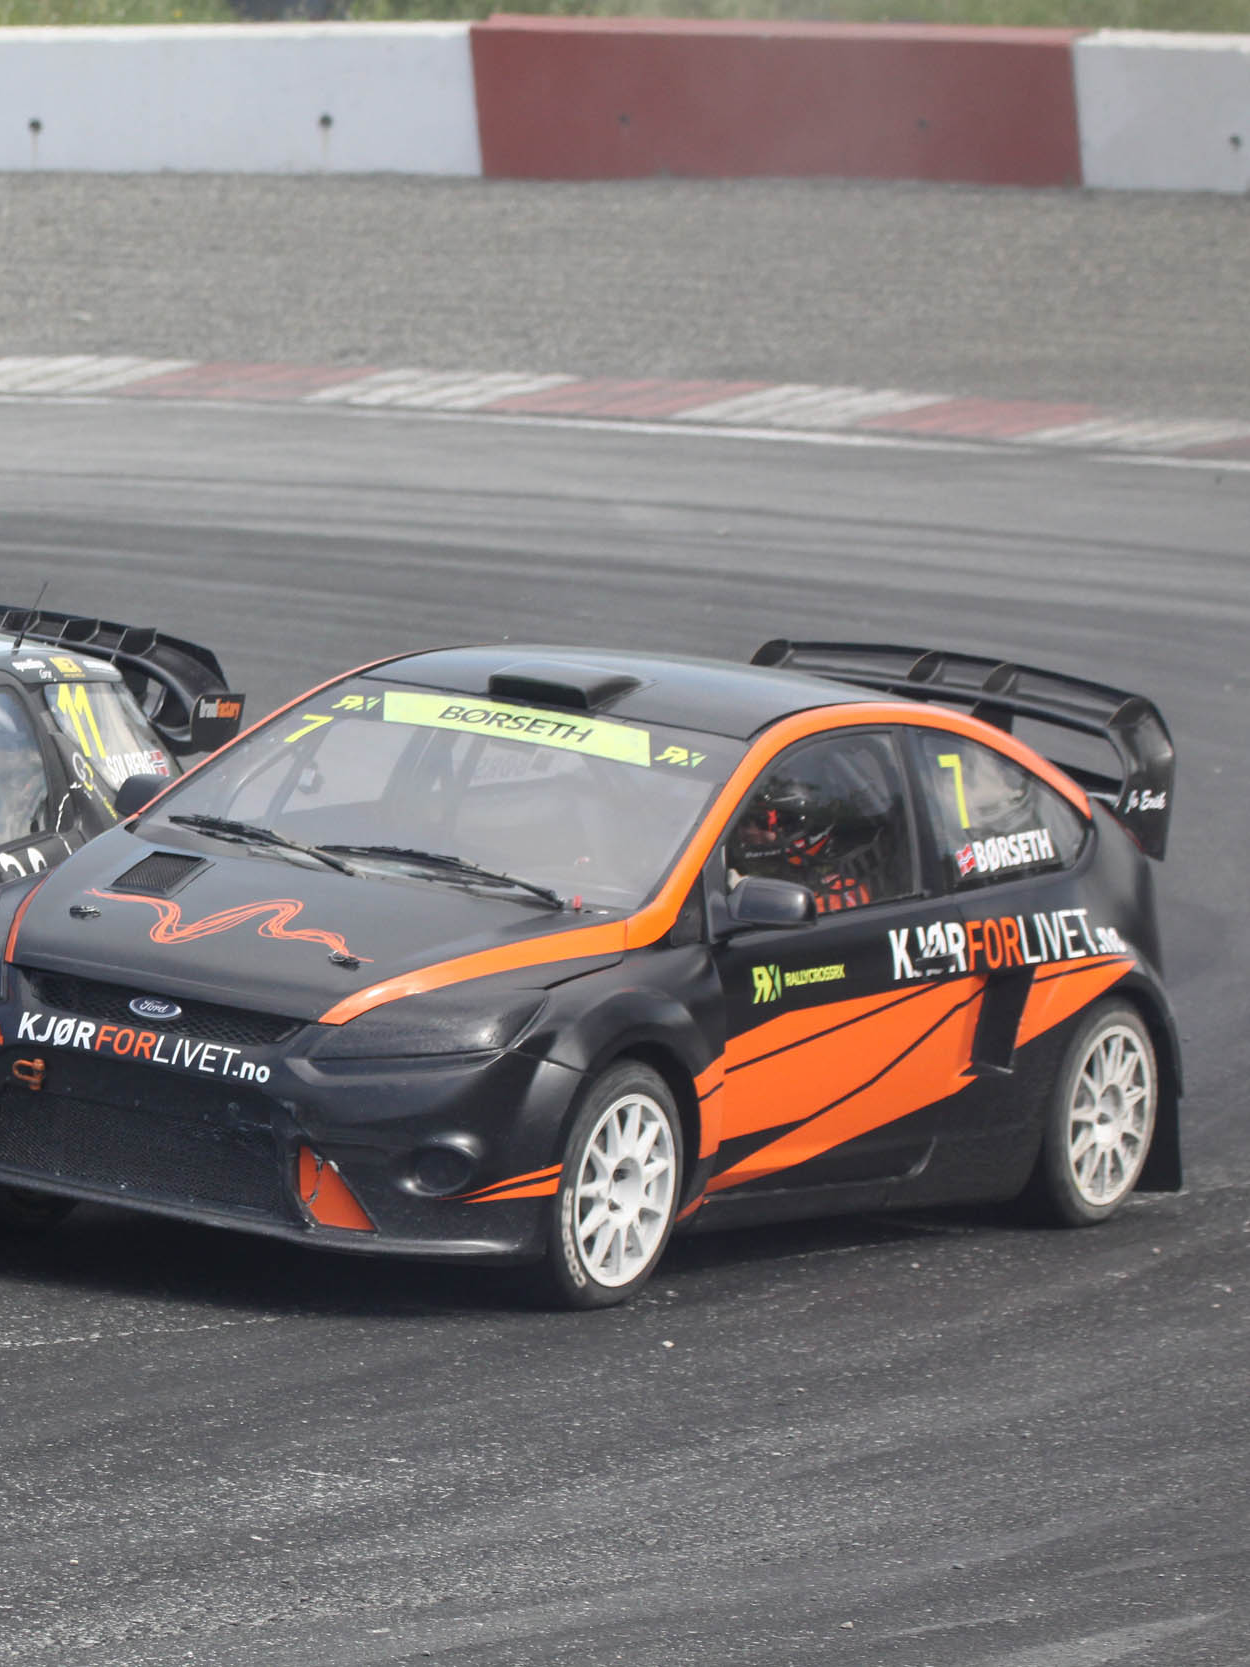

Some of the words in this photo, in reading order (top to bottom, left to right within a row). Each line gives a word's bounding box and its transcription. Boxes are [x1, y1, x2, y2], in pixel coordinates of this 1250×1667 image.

[57, 682, 107, 759] 11
[284, 714, 334, 743] 7
[437, 704, 594, 744] BØRSETH
[937, 754, 970, 829] 7
[973, 828, 1055, 873] BØRSETH
[140, 1000, 170, 1014] Ford
[17, 1012, 271, 1084] KJØRFORLIVET.no
